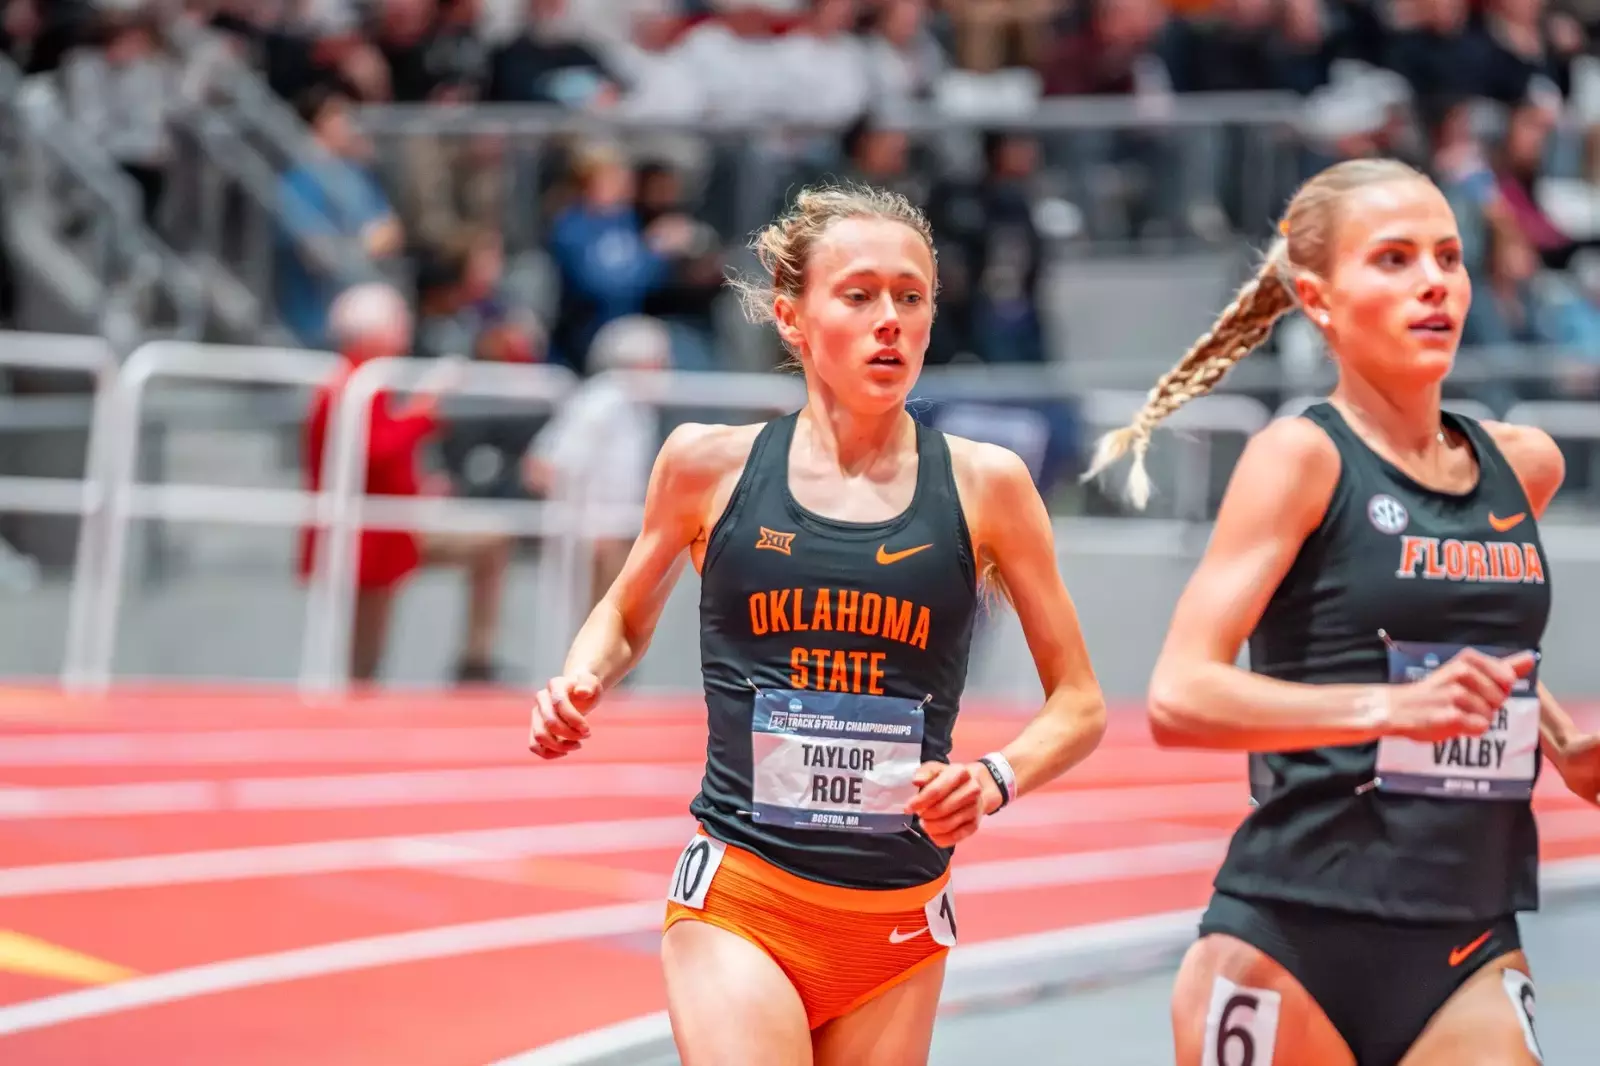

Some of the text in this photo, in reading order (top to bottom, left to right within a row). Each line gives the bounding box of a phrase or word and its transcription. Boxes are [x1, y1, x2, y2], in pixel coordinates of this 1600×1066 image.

[1395, 535, 1545, 584] FLORIDA
[749, 588, 931, 650] OKLAHOMA
[790, 647, 886, 695] STATE
[788, 717, 911, 736] TRACK & FIELD CHAMPIONSHIPS
[801, 743, 875, 771] TAYLOR
[1433, 735, 1507, 769] VALBY
[811, 774, 863, 805] ROE
[811, 813, 845, 825] BOSTON,
[846, 816, 859, 826] MA
[673, 840, 710, 901] 10
[1216, 994, 1261, 1066] 6
